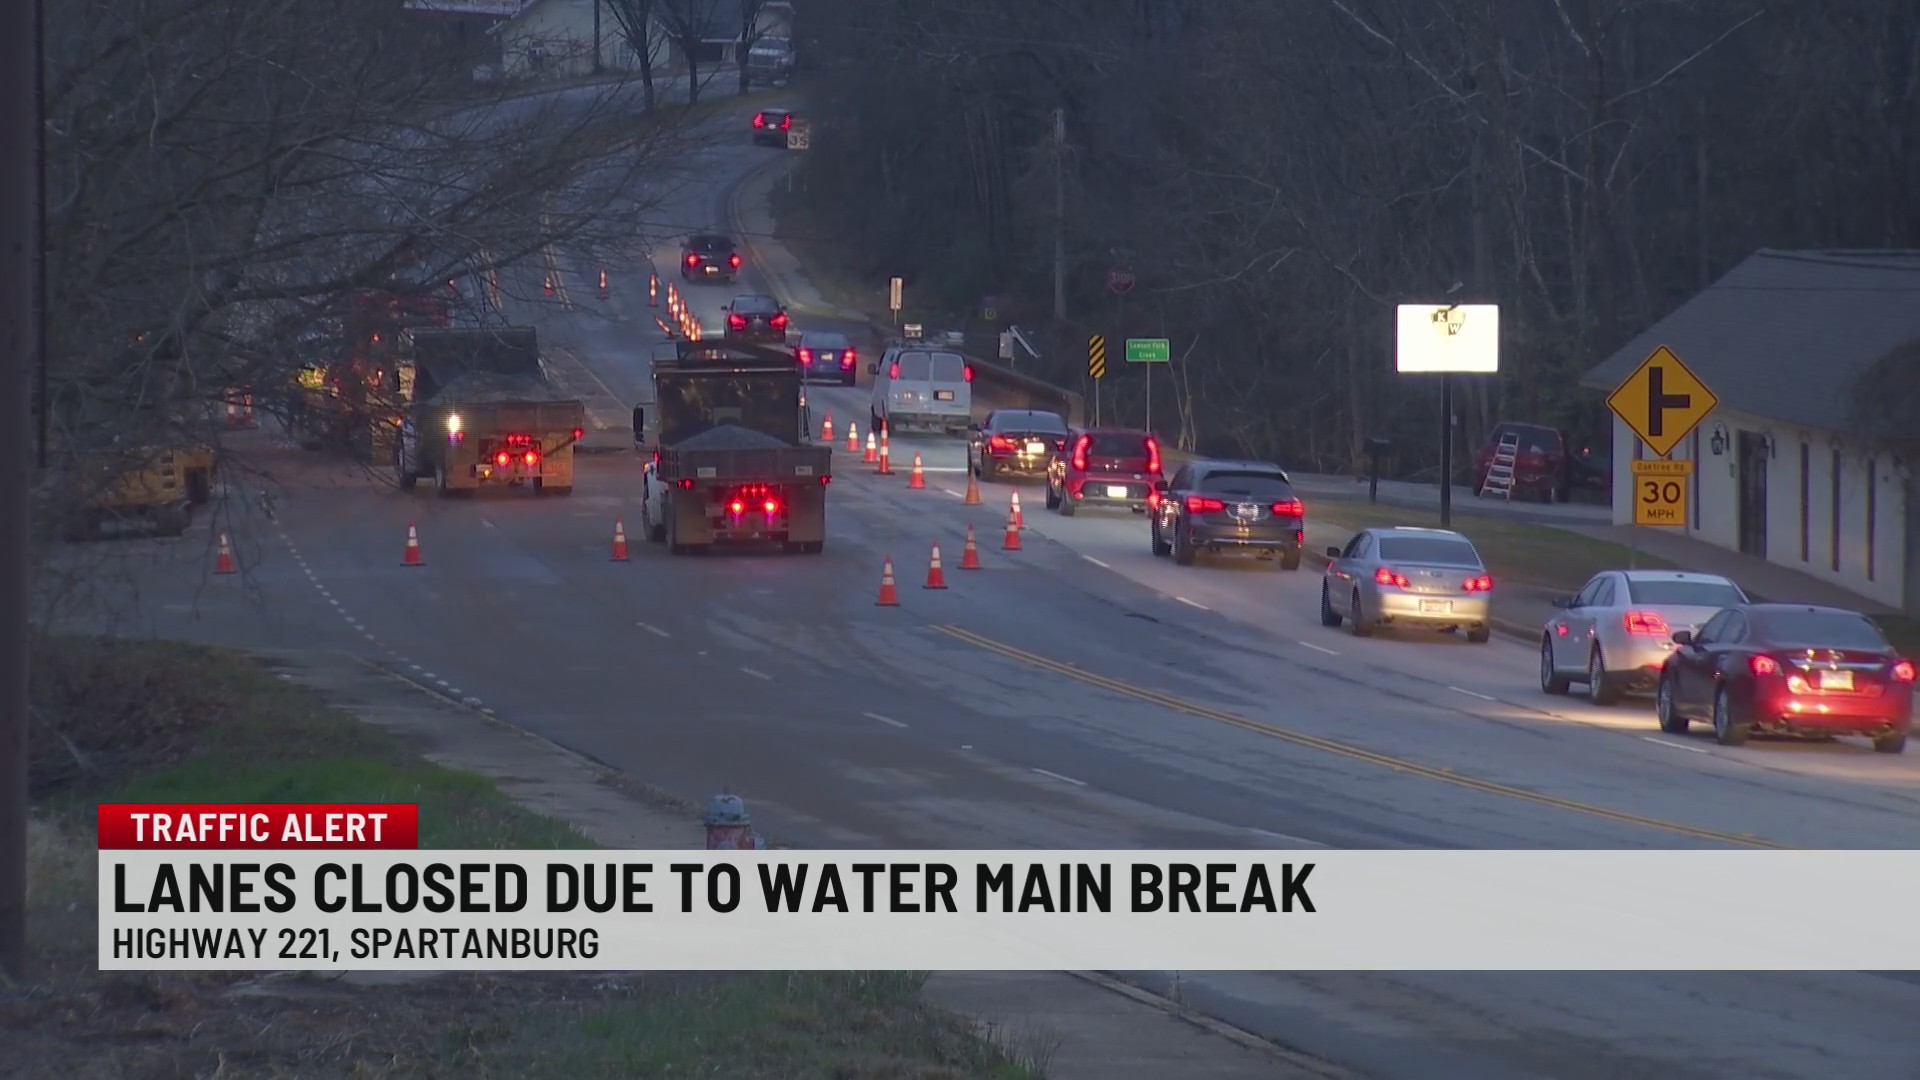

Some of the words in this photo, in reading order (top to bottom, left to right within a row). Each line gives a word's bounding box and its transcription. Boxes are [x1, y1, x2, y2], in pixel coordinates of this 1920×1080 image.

[789, 134, 808, 146] 35
[1642, 481, 1681, 504] 30
[1647, 509, 1675, 519] MPH
